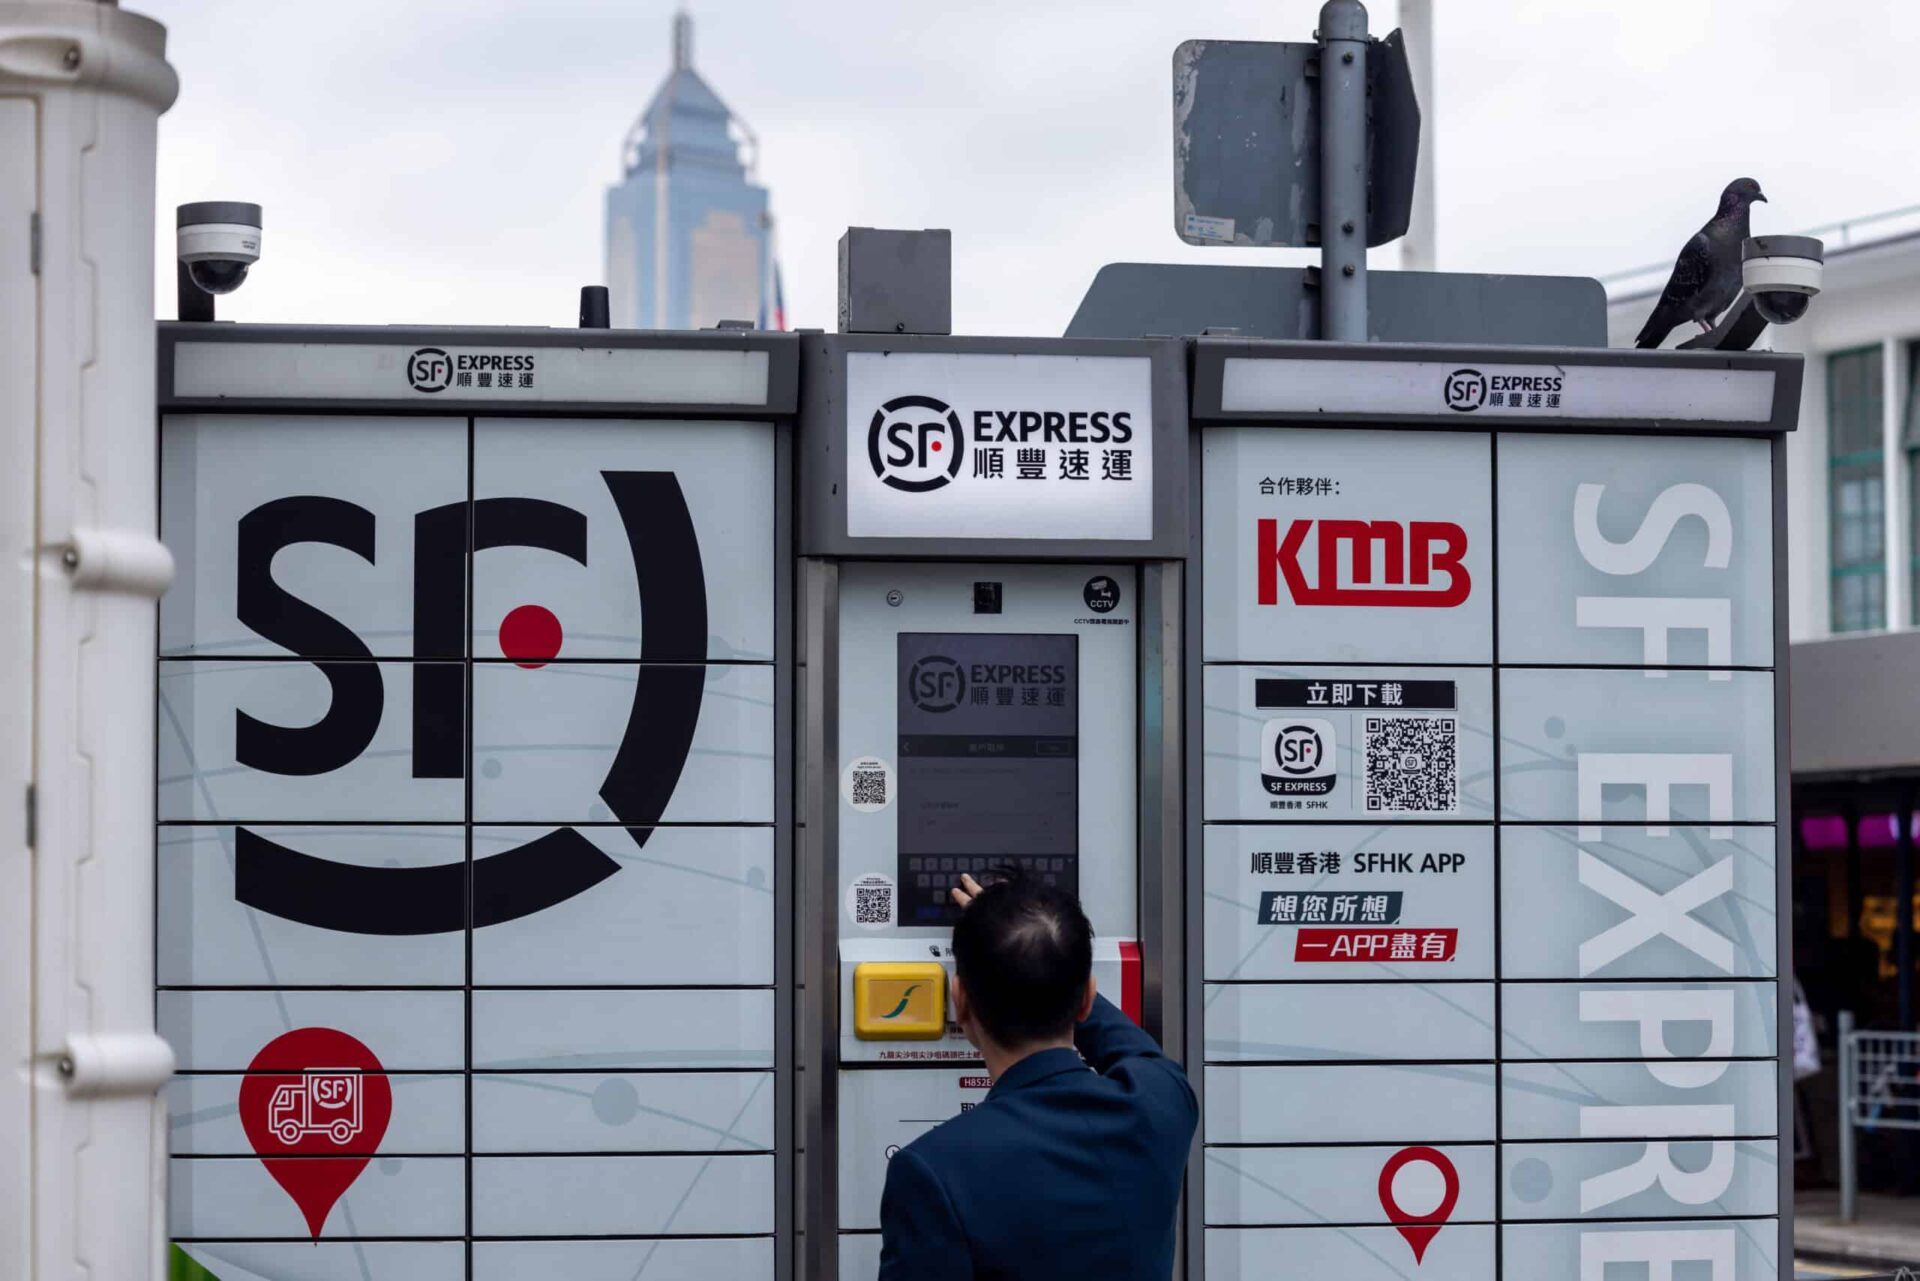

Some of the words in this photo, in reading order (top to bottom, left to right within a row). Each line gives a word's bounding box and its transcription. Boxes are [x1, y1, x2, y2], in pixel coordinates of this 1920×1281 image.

[457, 355, 535, 371] EXPRESS
[456, 371, 534, 388] 順豐速運
[1490, 375, 1563, 392] EXPRESS
[1488, 392, 1562, 409] 順豐速運
[973, 410, 1133, 444] EXPRESS
[972, 447, 1133, 481] 順豐速運
[1572, 481, 1734, 682] SF
[1090, 599, 1114, 608] CCTV
[970, 664, 1066, 685] EXPRESS
[970, 686, 1067, 708] 順豐速運
[1306, 682, 1403, 706] 立即下載
[1270, 782, 1282, 792] SF
[1284, 782, 1327, 793] EXPRESS
[1306, 801, 1328, 809] SFHK
[1250, 851, 1341, 875] 順豐香港
[1353, 852, 1414, 873] SFHK
[1419, 853, 1466, 873] APP
[1270, 894, 1388, 922] 想您所想
[1302, 932, 1448, 960] 一APP盡有
